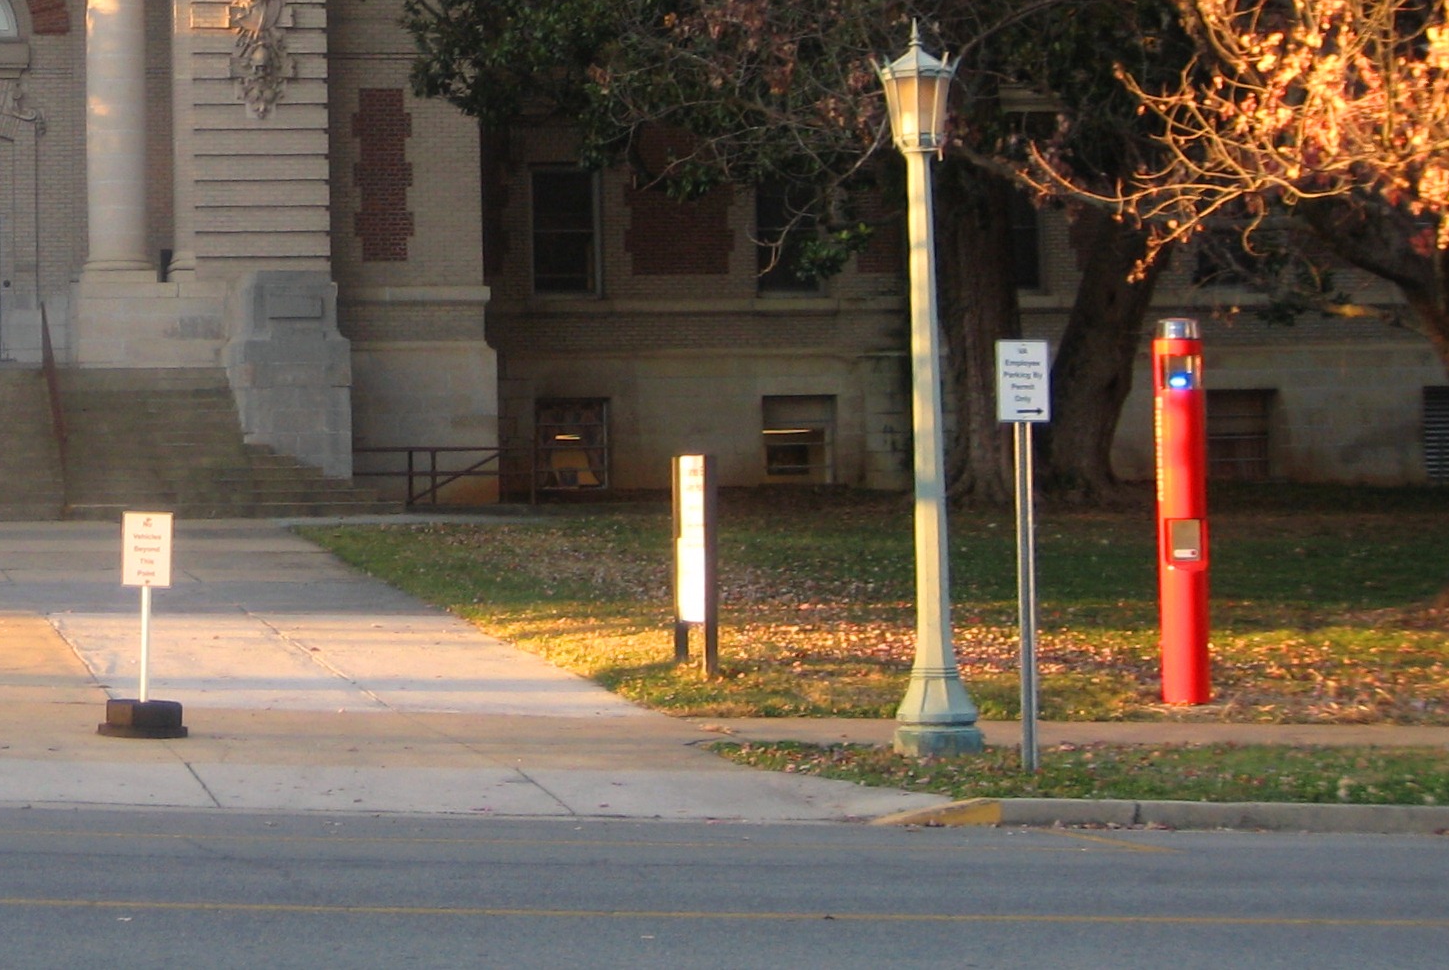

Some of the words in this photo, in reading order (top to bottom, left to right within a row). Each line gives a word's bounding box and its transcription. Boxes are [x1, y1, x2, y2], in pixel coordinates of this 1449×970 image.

[1005, 359, 1040, 367] Employee
[1004, 371, 1031, 379] Parking
[1033, 371, 1043, 379] By
[1015, 395, 1031, 403] Only
[134, 545, 160, 553] Beyond
